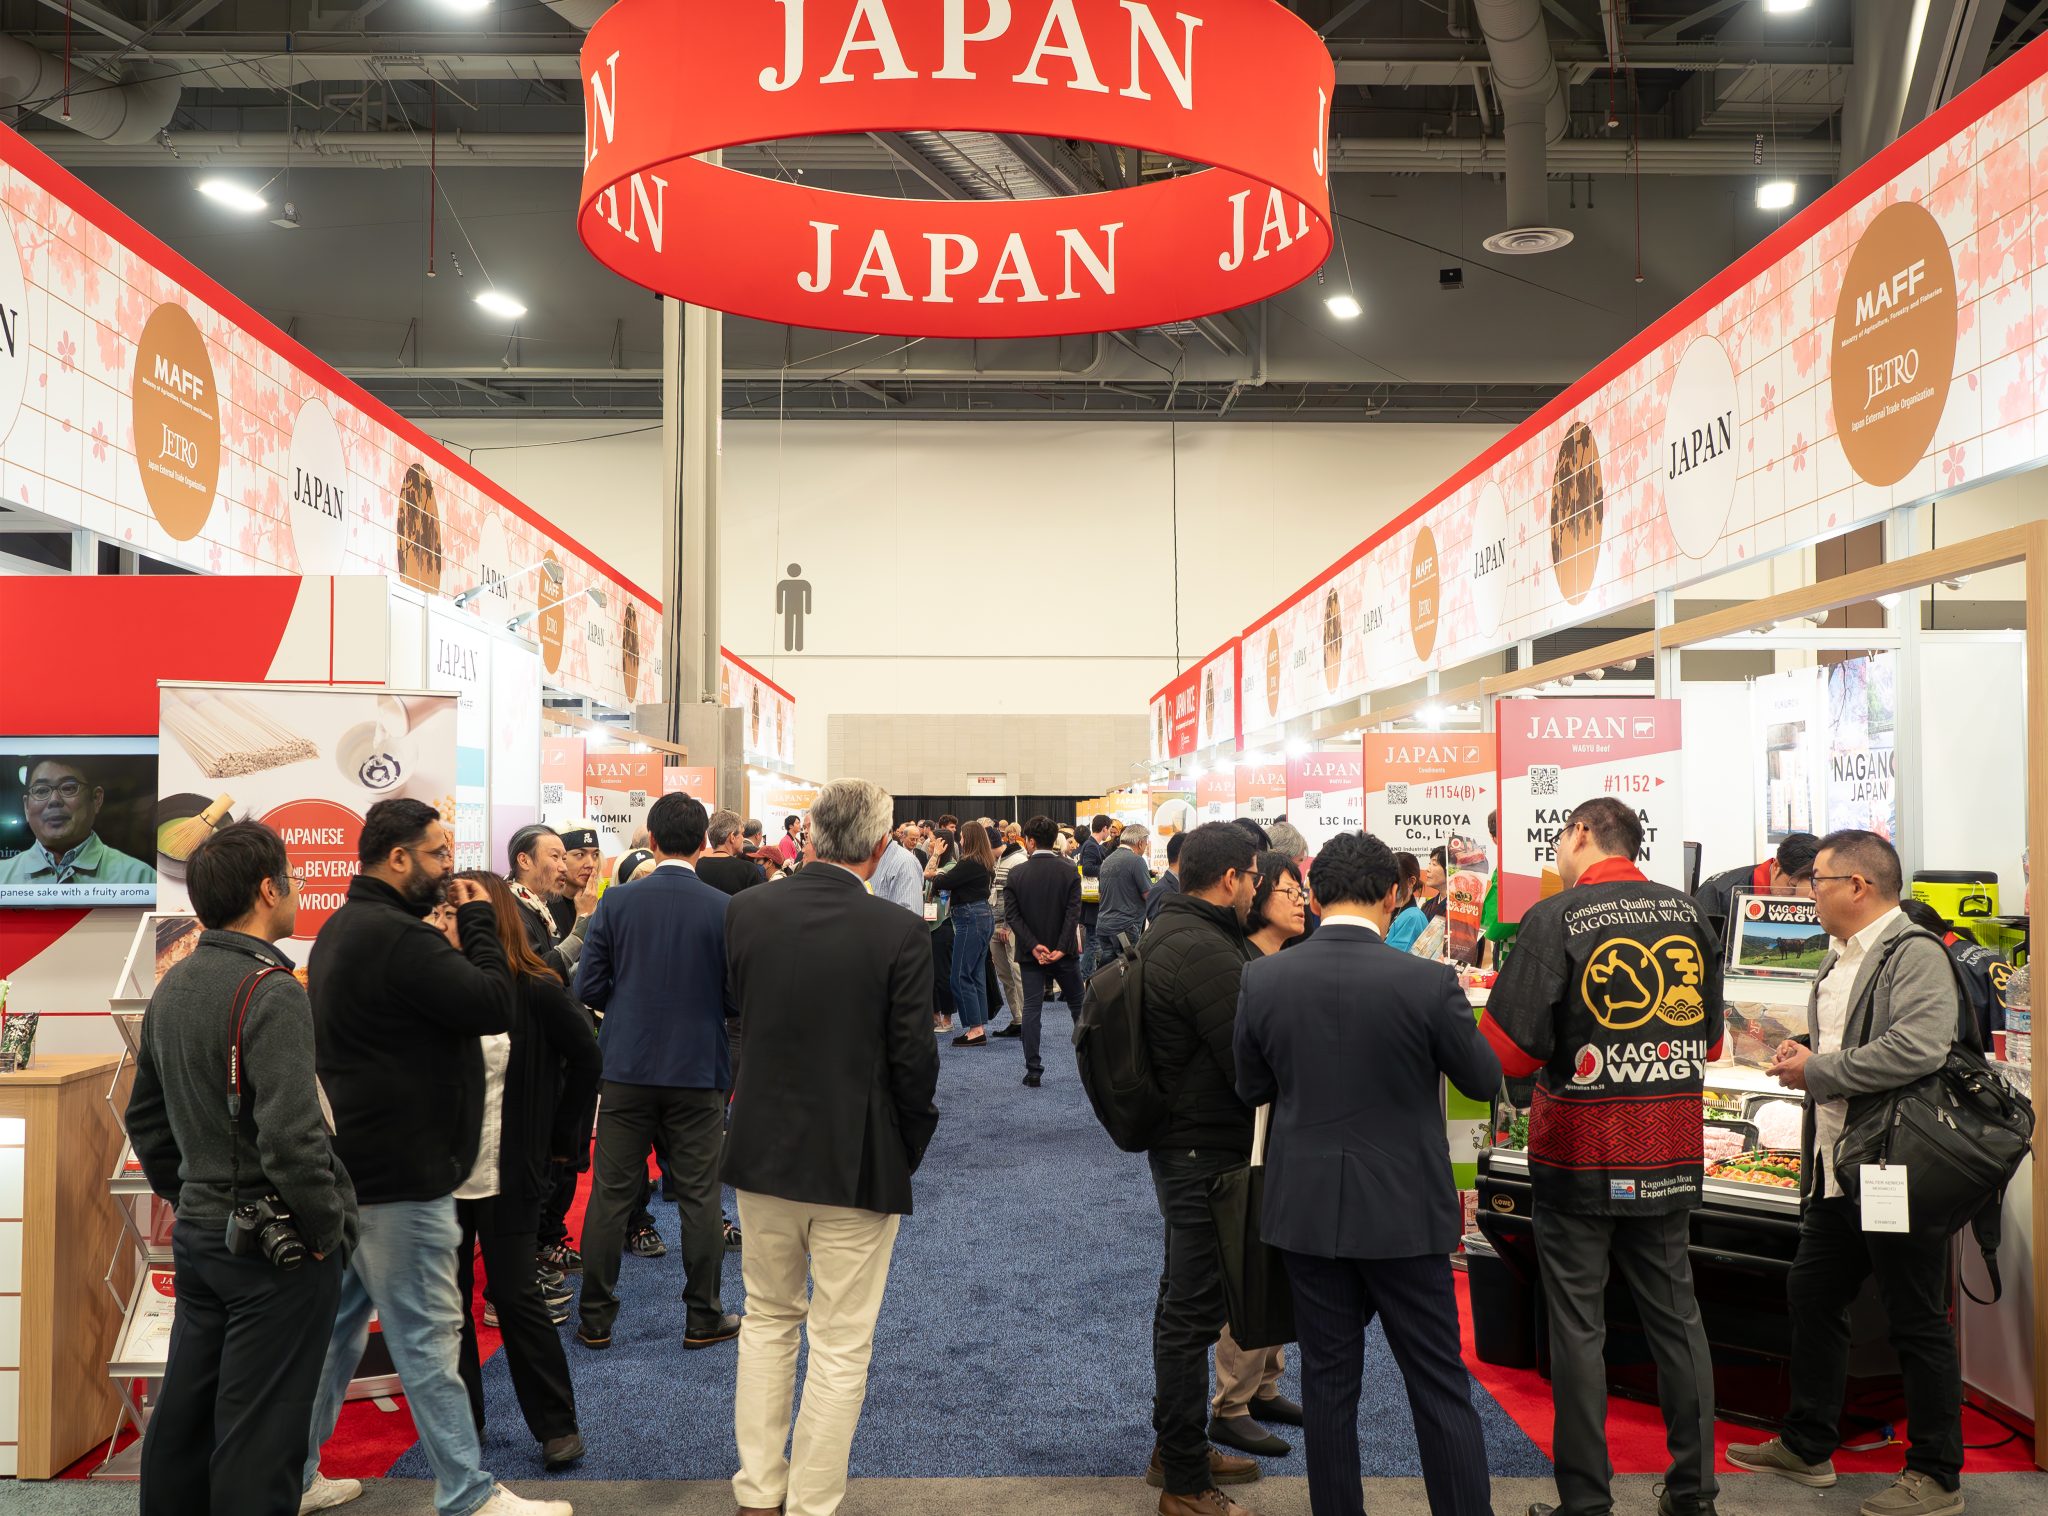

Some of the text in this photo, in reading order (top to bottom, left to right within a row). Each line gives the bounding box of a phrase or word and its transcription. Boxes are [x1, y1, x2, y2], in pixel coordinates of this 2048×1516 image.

[758, 0, 1203, 110] JAPAN
[797, 220, 1124, 304] JAPAN
[1855, 258, 1925, 327] MAFF
[154, 354, 204, 401] MAFF
[1864, 348, 1919, 410] JETRO
[1865, 408, 1886, 425] External
[1886, 403, 1900, 417] Trade
[1900, 387, 1935, 408] Organization
[158, 423, 198, 469] JETRO
[1669, 410, 1732, 480] JAPAN
[294, 467, 344, 521] JAPAN
[1474, 538, 1506, 579] JAPAN
[1363, 604, 1384, 635] JAPAN
[588, 620, 605, 648] JAPAN
[437, 639, 478, 682] JAPAN
[1527, 716, 1628, 739] JAPAN
[1385, 746, 1458, 763] JAPAN
[585, 763, 632, 776] APAN
[1303, 762, 1361, 777] JAPAN
[1426, 785, 1476, 801] #1154(B)
[1604, 774, 1650, 792] #1152
[1851, 781, 1887, 802] JAPAN
[588, 795, 604, 806] 157
[590, 815, 631, 823] MOMIKI
[602, 825, 620, 833] Inc.
[1320, 817, 1362, 826] L3C Inc.
[1395, 814, 1471, 826] FUKUROYA
[1406, 828, 1430, 840] Co.,
[37, 887, 58, 896] sake
[58, 887, 81, 896] with
[92, 887, 117, 899] fruity
[1564, 900, 1618, 922] Consistent
[1620, 898, 1656, 911] Quality
[1659, 898, 1677, 908] and
[1568, 911, 1659, 936] KAGOSHIMA
[1641, 1177, 1676, 1190] Kagoshima
[1641, 1184, 1696, 1199] Export Federation
